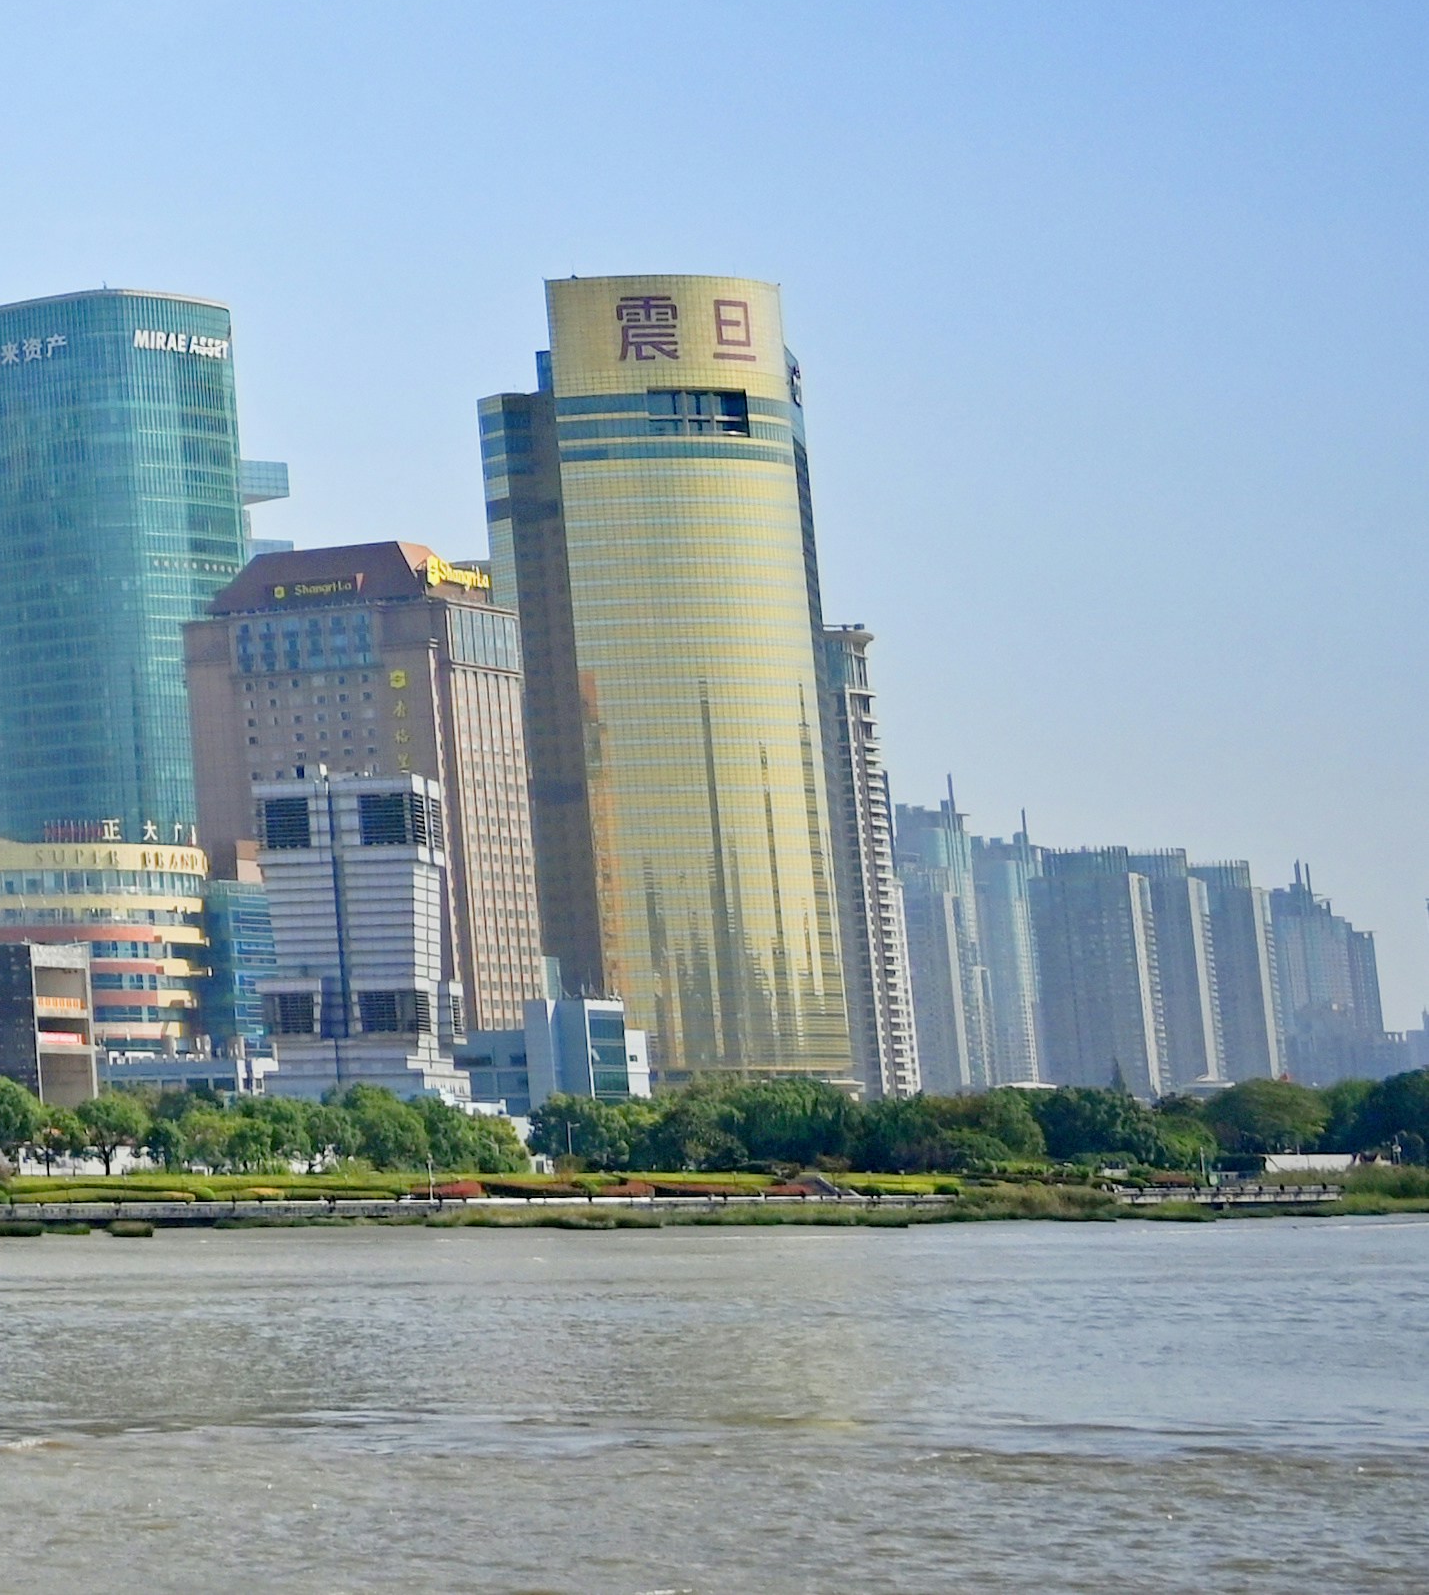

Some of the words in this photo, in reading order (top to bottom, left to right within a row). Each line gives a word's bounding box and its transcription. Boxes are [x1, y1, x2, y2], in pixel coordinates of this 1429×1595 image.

[133, 329, 187, 353] MIRAE
[189, 335, 229, 359] ASSET
[616, 296, 756, 362] 震旦
[35, 849, 120, 866] SUPER
